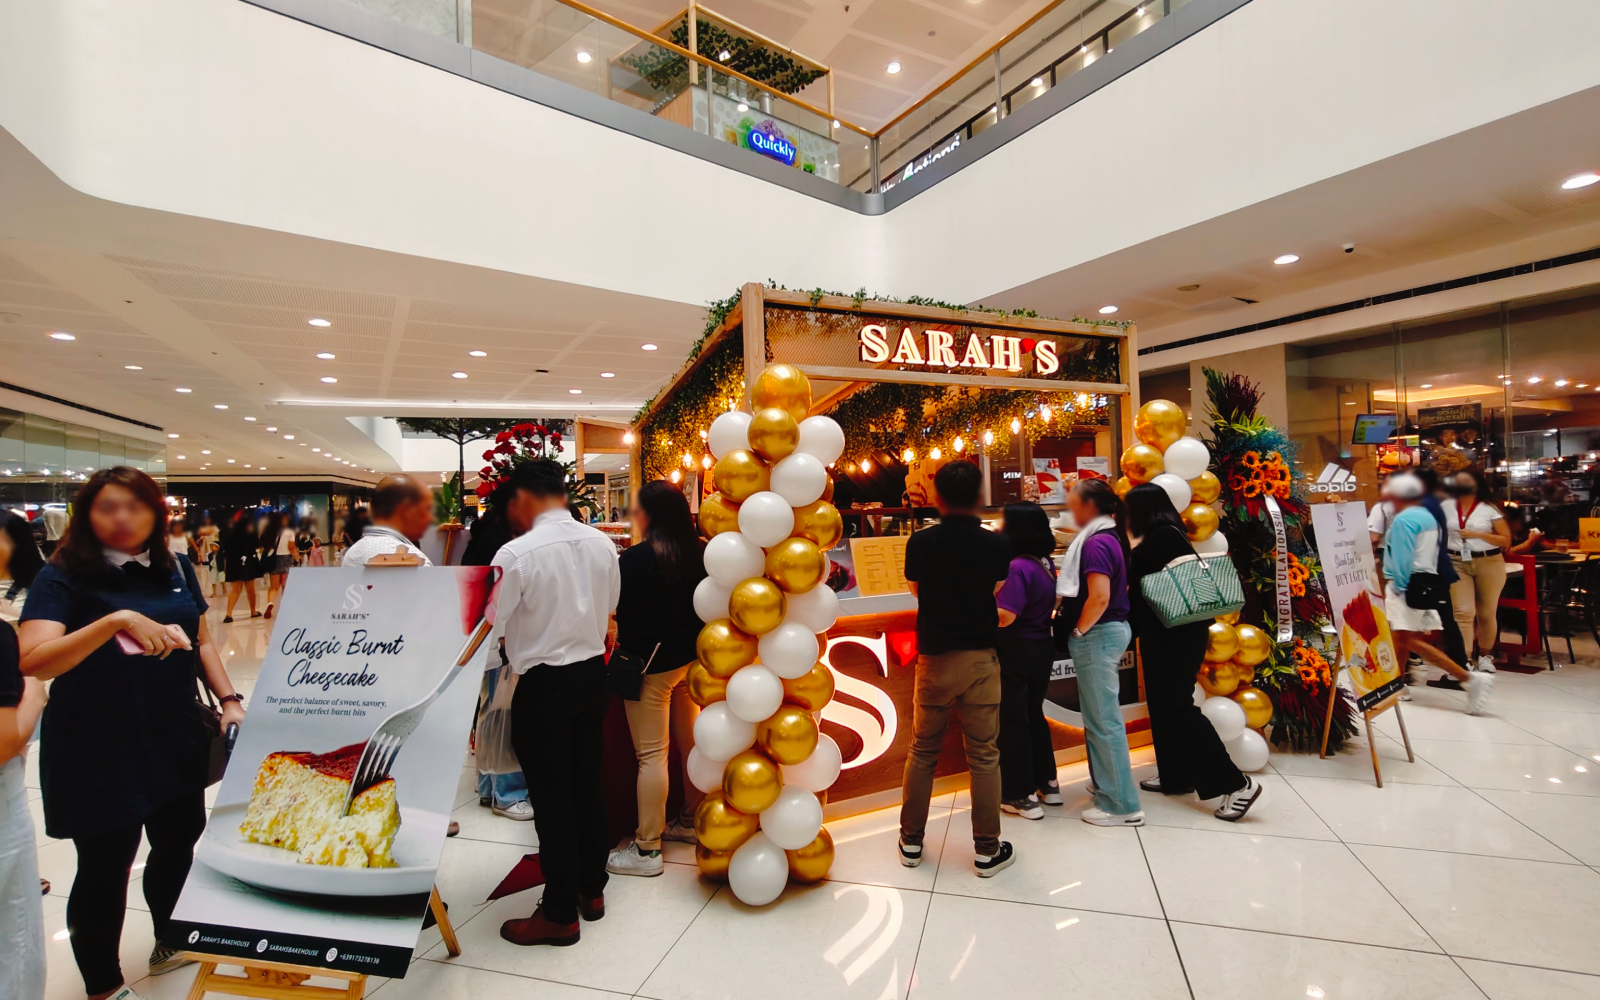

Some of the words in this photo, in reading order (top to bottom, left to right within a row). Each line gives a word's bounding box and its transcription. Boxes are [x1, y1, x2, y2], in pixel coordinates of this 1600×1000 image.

[752, 132, 795, 161] Quickly
[1335, 572, 1348, 587] BUY
[1353, 569, 1365, 582] GET
[281, 627, 342, 660] Classic
[346, 629, 404, 656] Burnt
[287, 658, 379, 692] Cheesecake
[265, 696, 278, 704] The
[278, 696, 303, 705] perfect
[303, 697, 330, 705] balance
[331, 698, 340, 706] of
[339, 699, 361, 707] sweet,
[362, 701, 387, 709] savory,
[305, 708, 330, 716] perfect
[330, 708, 351, 716] burnt
[352, 709, 366, 717] bits
[200, 935, 220, 944] SARAH'S
[220, 938, 251, 948] BAKEHOUSE
[268, 944, 319, 957] SARAHSBAKEHOUSE
